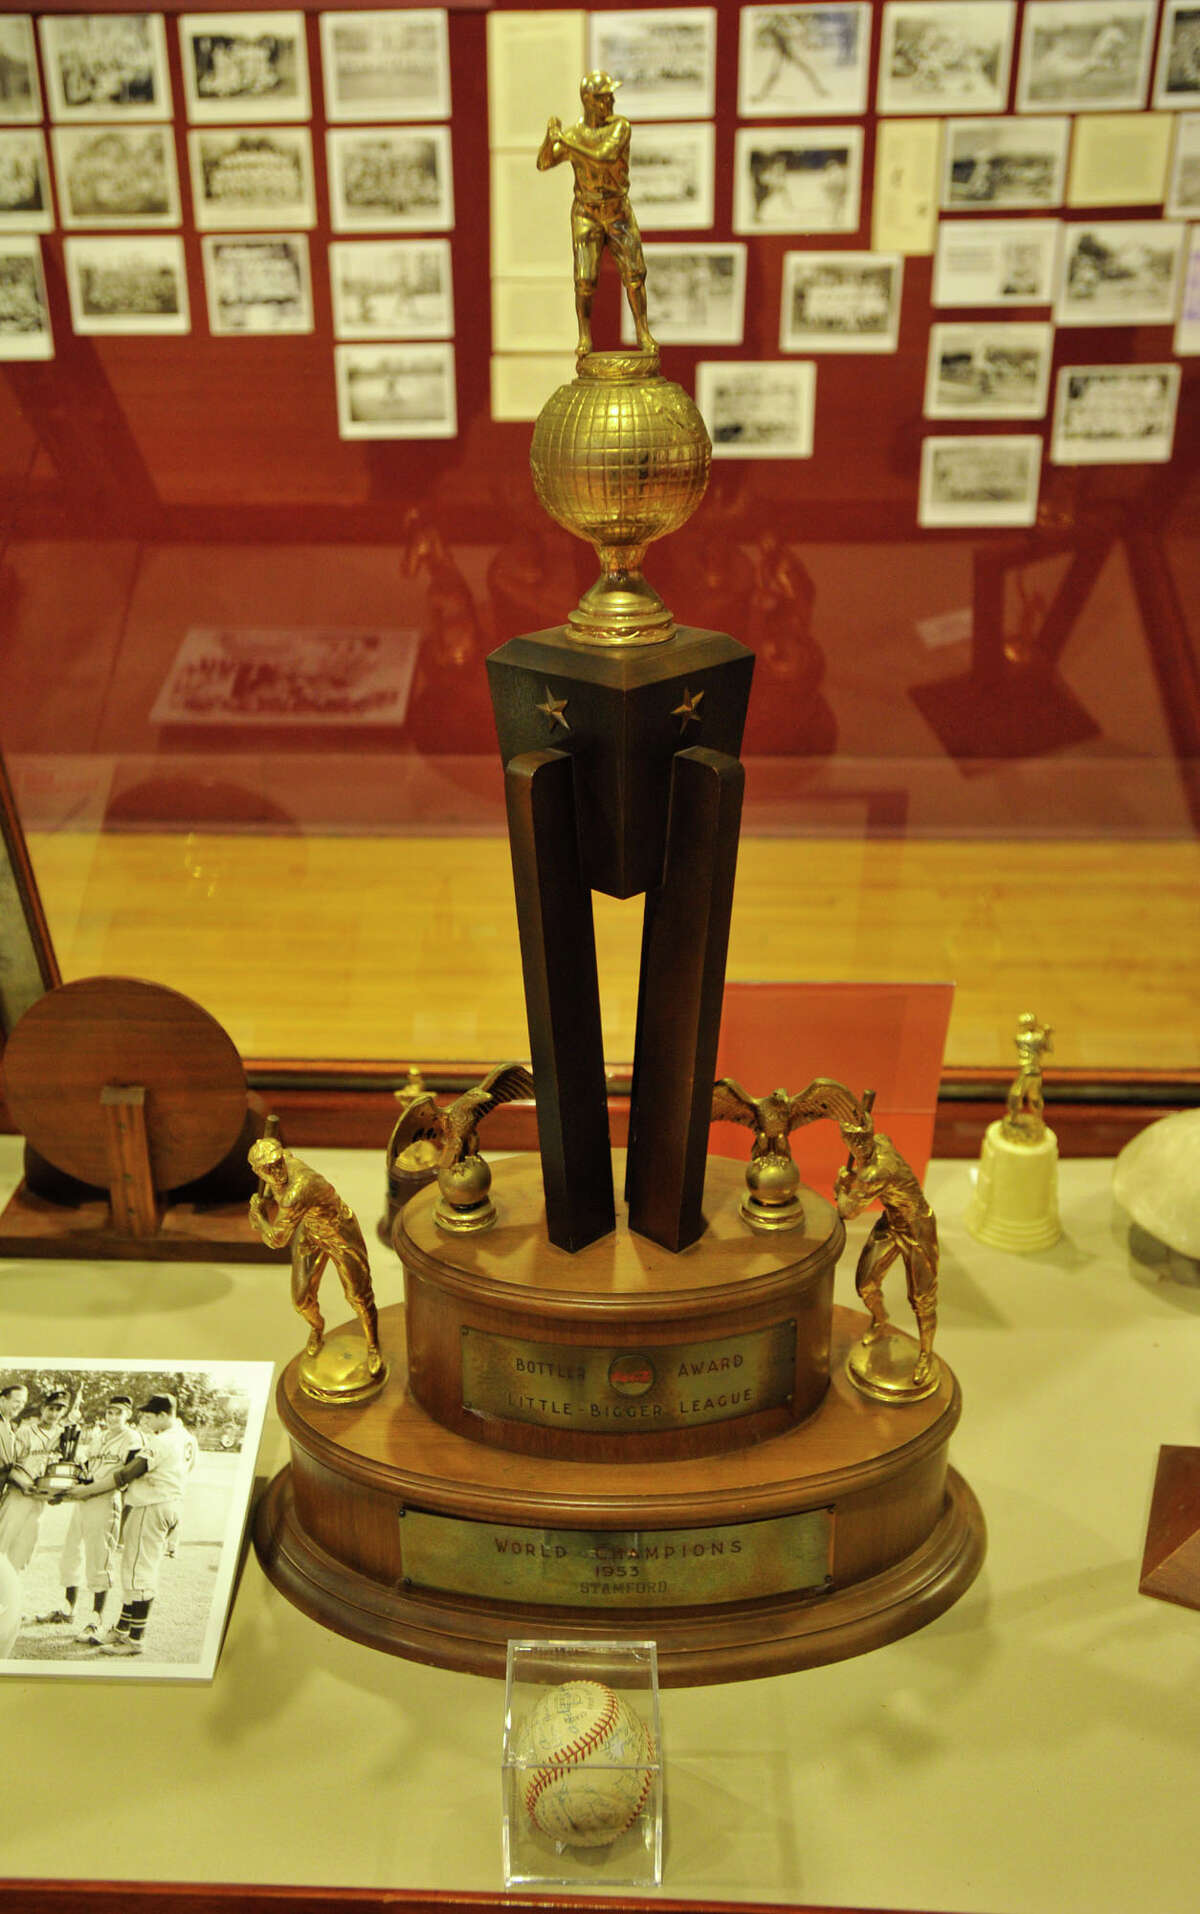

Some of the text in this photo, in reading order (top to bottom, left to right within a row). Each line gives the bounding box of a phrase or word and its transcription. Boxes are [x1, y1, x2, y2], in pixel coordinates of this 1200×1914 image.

[678, 1354, 744, 1377] AWARD
[680, 1388, 753, 1414] LEAGUE
[494, 1537, 743, 1561] WORLD CHAMPIONS
[595, 1565, 640, 1577] 1953
[579, 1581, 668, 1594] STAMFORD
